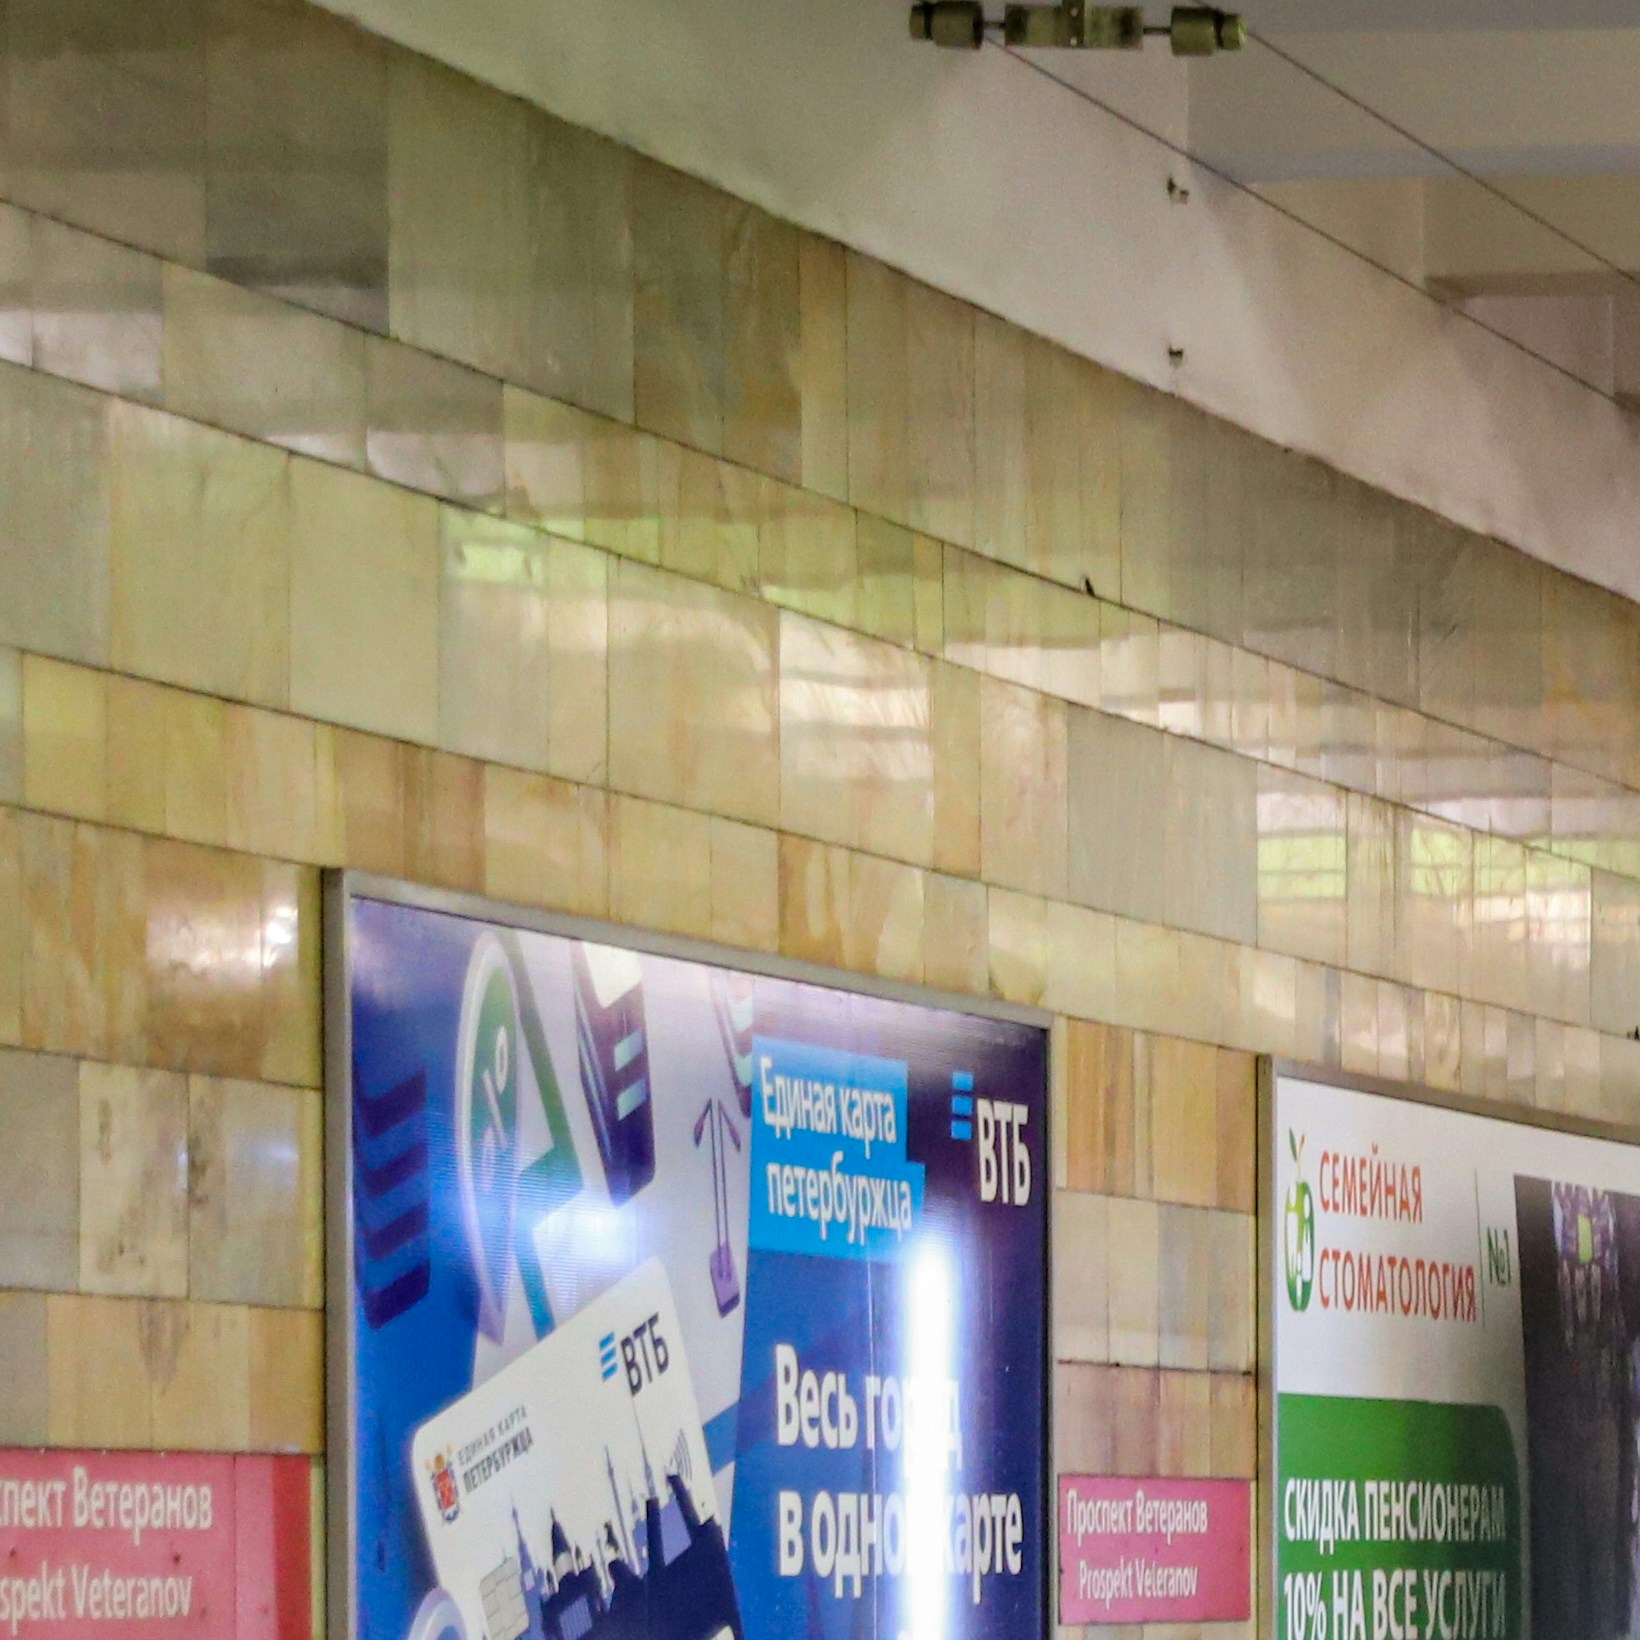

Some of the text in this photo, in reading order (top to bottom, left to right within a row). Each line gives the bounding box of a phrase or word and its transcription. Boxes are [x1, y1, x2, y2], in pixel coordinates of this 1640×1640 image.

[760, 1055, 897, 1160] Единая карта
[976, 1098, 1032, 1207] ВТБ
[1319, 1143, 1424, 1224] СЕМЕЙНАЯ
[766, 1150, 913, 1247] петербуржца
[1319, 1247, 1478, 1323] СТОМАТОЛОГИЯ
[1485, 1226, 1512, 1287] №1
[620, 1311, 670, 1398] ВТБ
[775, 1343, 963, 1472] Весь год
[0, 1465, 213, 1547] пект Ветеранов
[1066, 1487, 1208, 1548] Проспект Ветеранов
[1284, 1477, 1506, 1556] СКИДКА ПЕНСИОНЕРАМ
[778, 1490, 1024, 1605] в одно арте
[1079, 1555, 1199, 1610] Prospekt Veteranov
[70, 1562, 193, 1619] Veteranov
